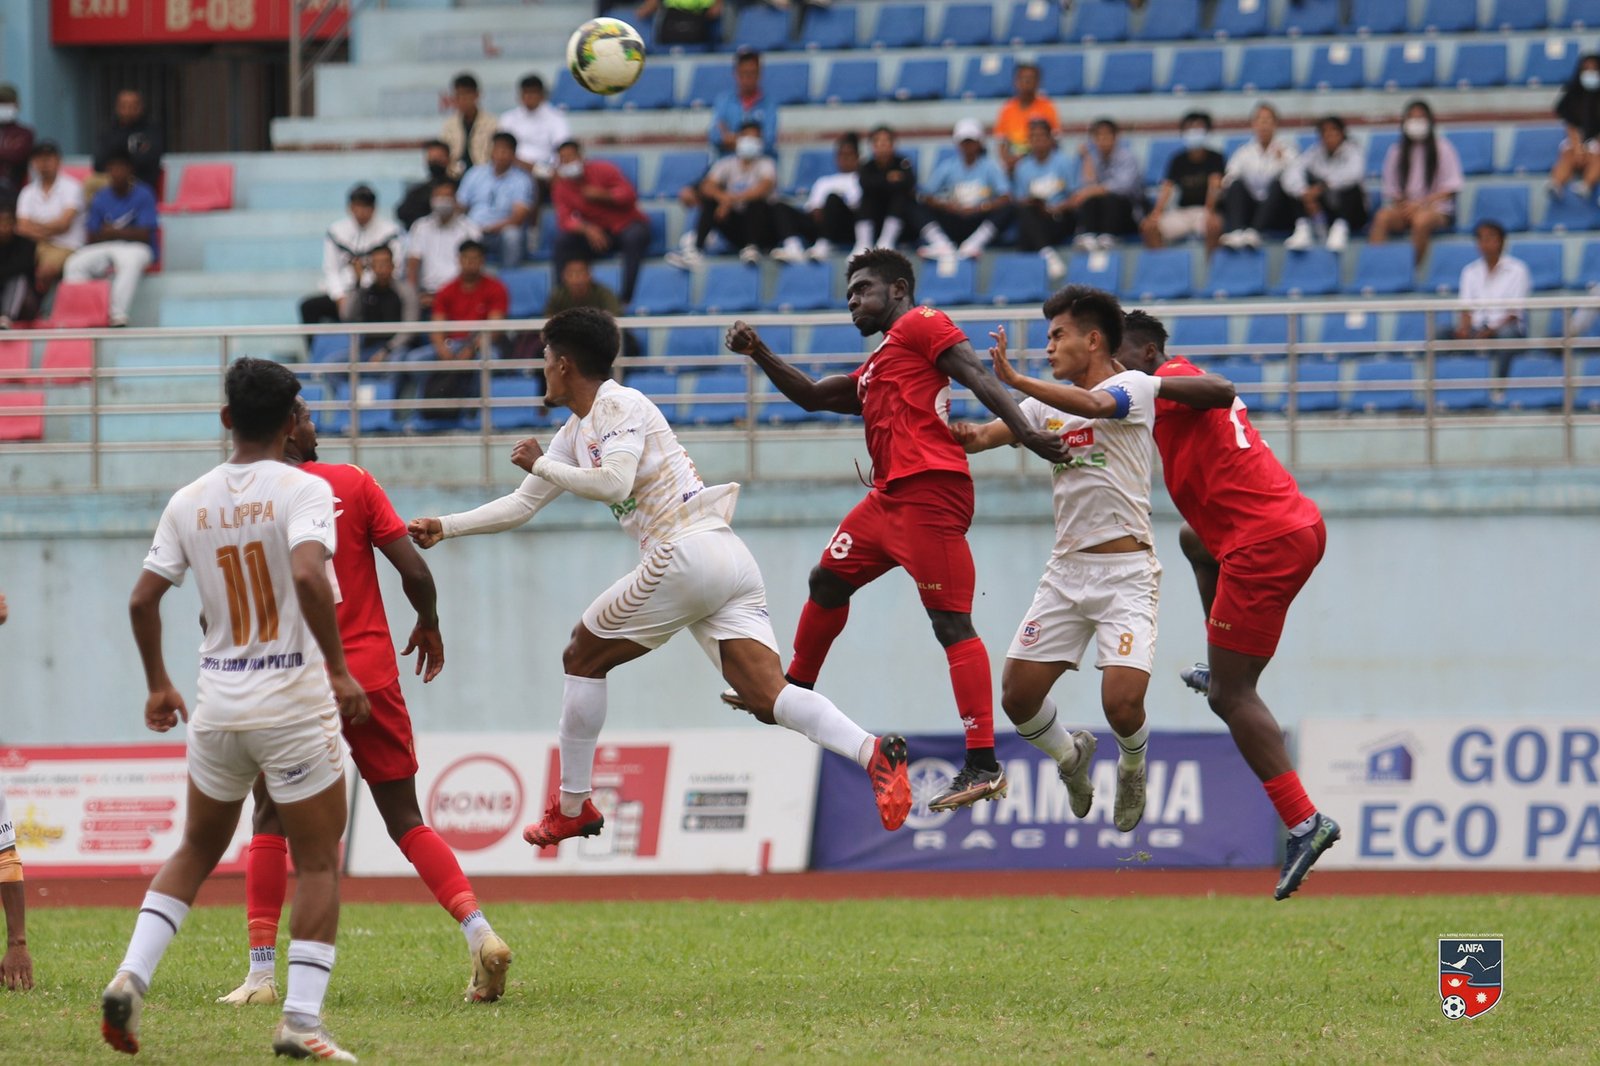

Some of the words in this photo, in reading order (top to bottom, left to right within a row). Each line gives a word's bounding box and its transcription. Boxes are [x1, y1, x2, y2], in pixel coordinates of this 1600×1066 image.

[69, 0, 129, 17] EXIT
[166, 0, 256, 31] B-08
[1067, 432, 1089, 444] net
[196, 507, 212, 530] R.
[220, 500, 275, 529] LOPPA
[825, 526, 853, 559] 8
[216, 541, 279, 647] 11
[1117, 632, 1134, 656] 8
[1448, 725, 1600, 785] GOR
[912, 828, 1185, 850] RACING
[1357, 801, 1499, 861] ECO
[1524, 801, 1600, 861] PA
